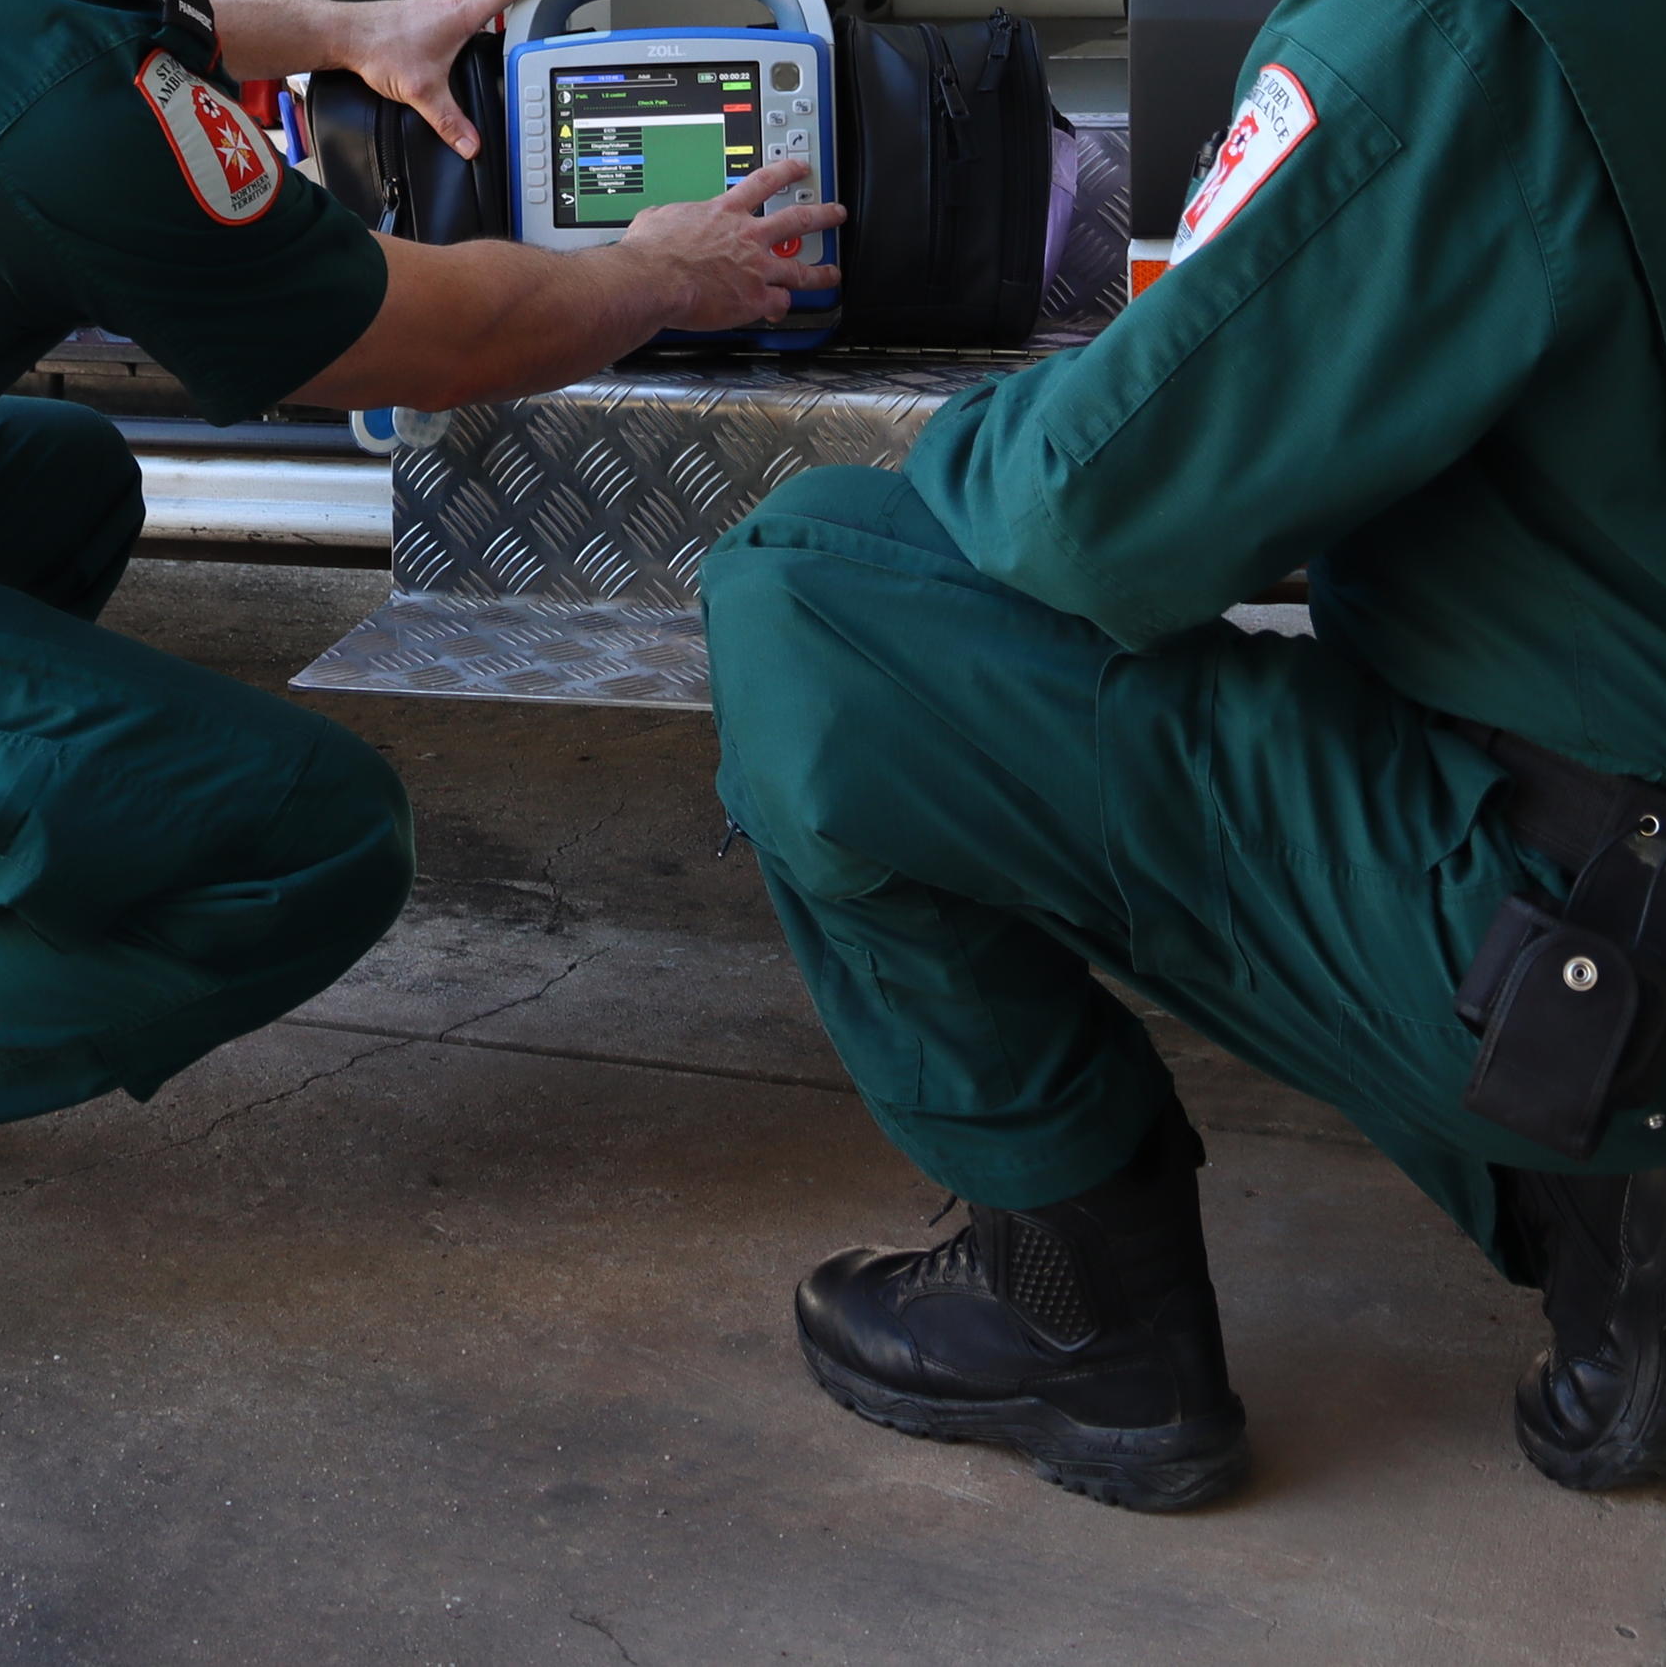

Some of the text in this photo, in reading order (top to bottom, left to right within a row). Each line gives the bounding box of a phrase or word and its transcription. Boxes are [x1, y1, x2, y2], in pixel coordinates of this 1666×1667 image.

[646, 44, 683, 58] ZOLL
[229, 173, 270, 201] NORTHERN
[231, 182, 272, 212] TERRITORY
